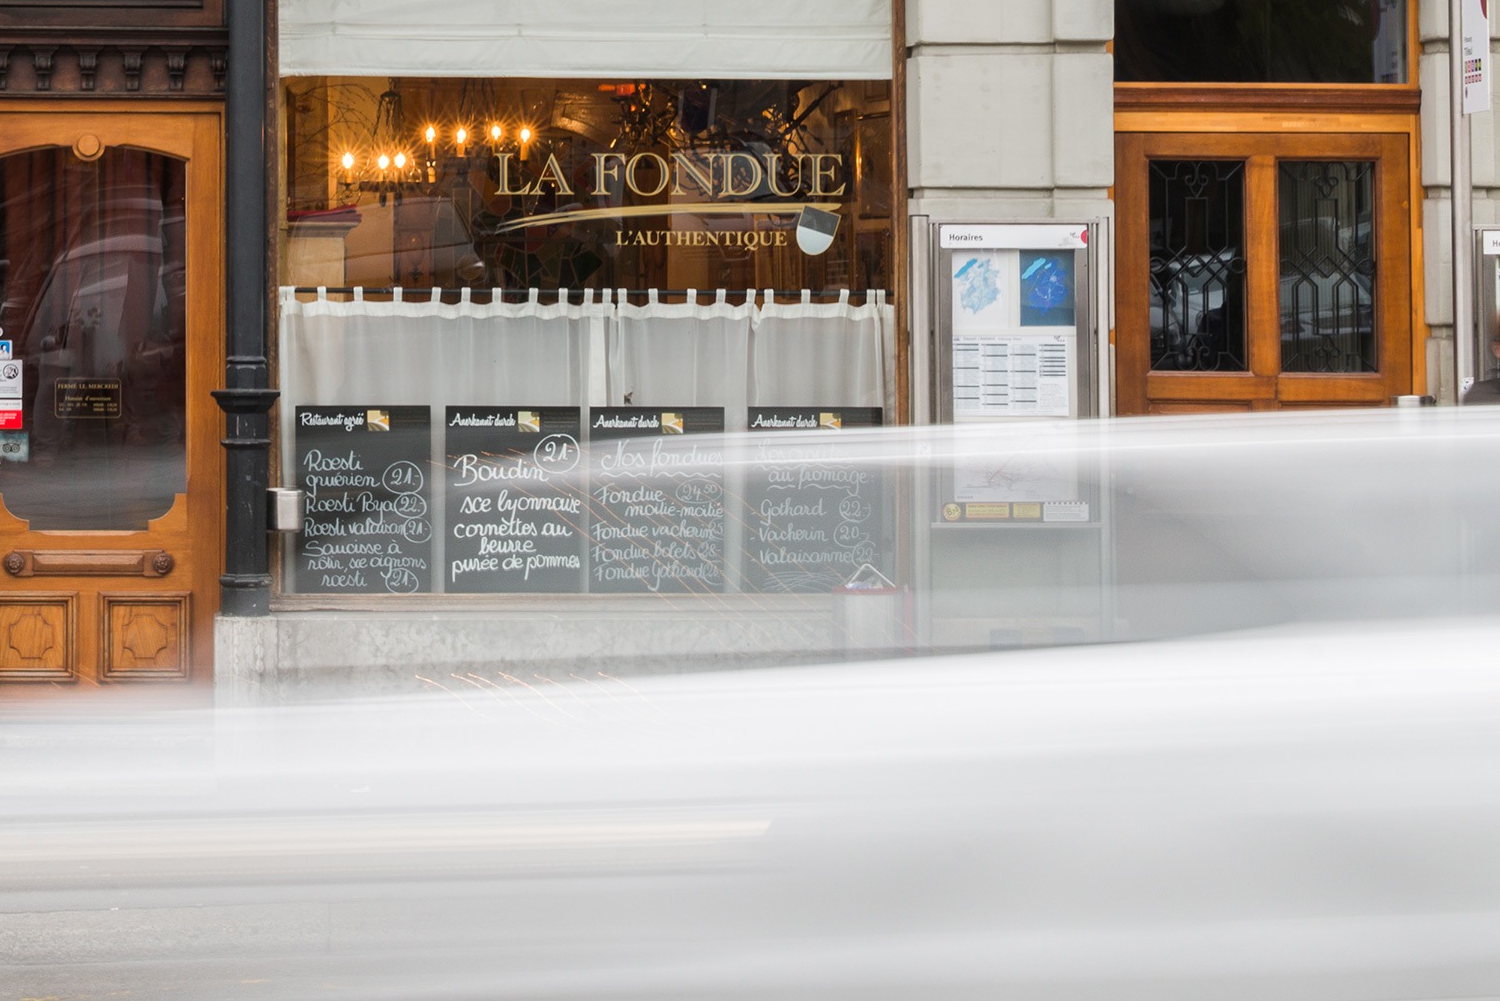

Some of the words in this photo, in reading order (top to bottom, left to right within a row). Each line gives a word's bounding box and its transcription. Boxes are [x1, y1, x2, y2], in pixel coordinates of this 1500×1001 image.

[494, 152, 574, 196] LA
[591, 152, 846, 197] FONDUE
[615, 230, 787, 251] L'AUTHENTIQUE
[300, 412, 343, 427] Restaurant
[449, 413, 494, 427] Anerkannt
[494, 413, 516, 427] durch
[593, 414, 638, 429] Anerkannt
[638, 414, 660, 429] durch
[751, 414, 796, 429] Anerkannt
[796, 414, 818, 428] durch
[303, 449, 363, 471] Roesti
[601, 439, 645, 470] Nos
[650, 438, 723, 477] fondues
[453, 454, 549, 487] Boudin
[768, 471, 795, 483] au
[306, 470, 380, 497] gruérien
[593, 482, 666, 505] Fondue
[304, 492, 355, 514] Roesti
[356, 491, 394, 525] Poya
[460, 496, 492, 514] sce
[497, 489, 581, 524] lyonnaise
[760, 497, 827, 526] Gothard
[303, 517, 347, 537] Roesti
[453, 518, 538, 538] cornettes
[541, 522, 573, 537] au
[590, 520, 649, 541] Fondue
[652, 519, 713, 540] vacherin
[759, 523, 828, 542] Vacherin
[302, 539, 383, 557] Saucisse
[387, 539, 402, 554] à
[478, 537, 537, 555] beurre
[590, 542, 650, 563] Fondue
[654, 540, 696, 559] bolets
[759, 546, 853, 564] Valaisanne
[370, 555, 426, 578] oignons
[452, 555, 498, 583] purée
[502, 554, 524, 570] de
[524, 554, 581, 581] pommes
[593, 561, 649, 582] Fondue
[647, 559, 704, 591] Gothard
[321, 570, 367, 587] roesti
